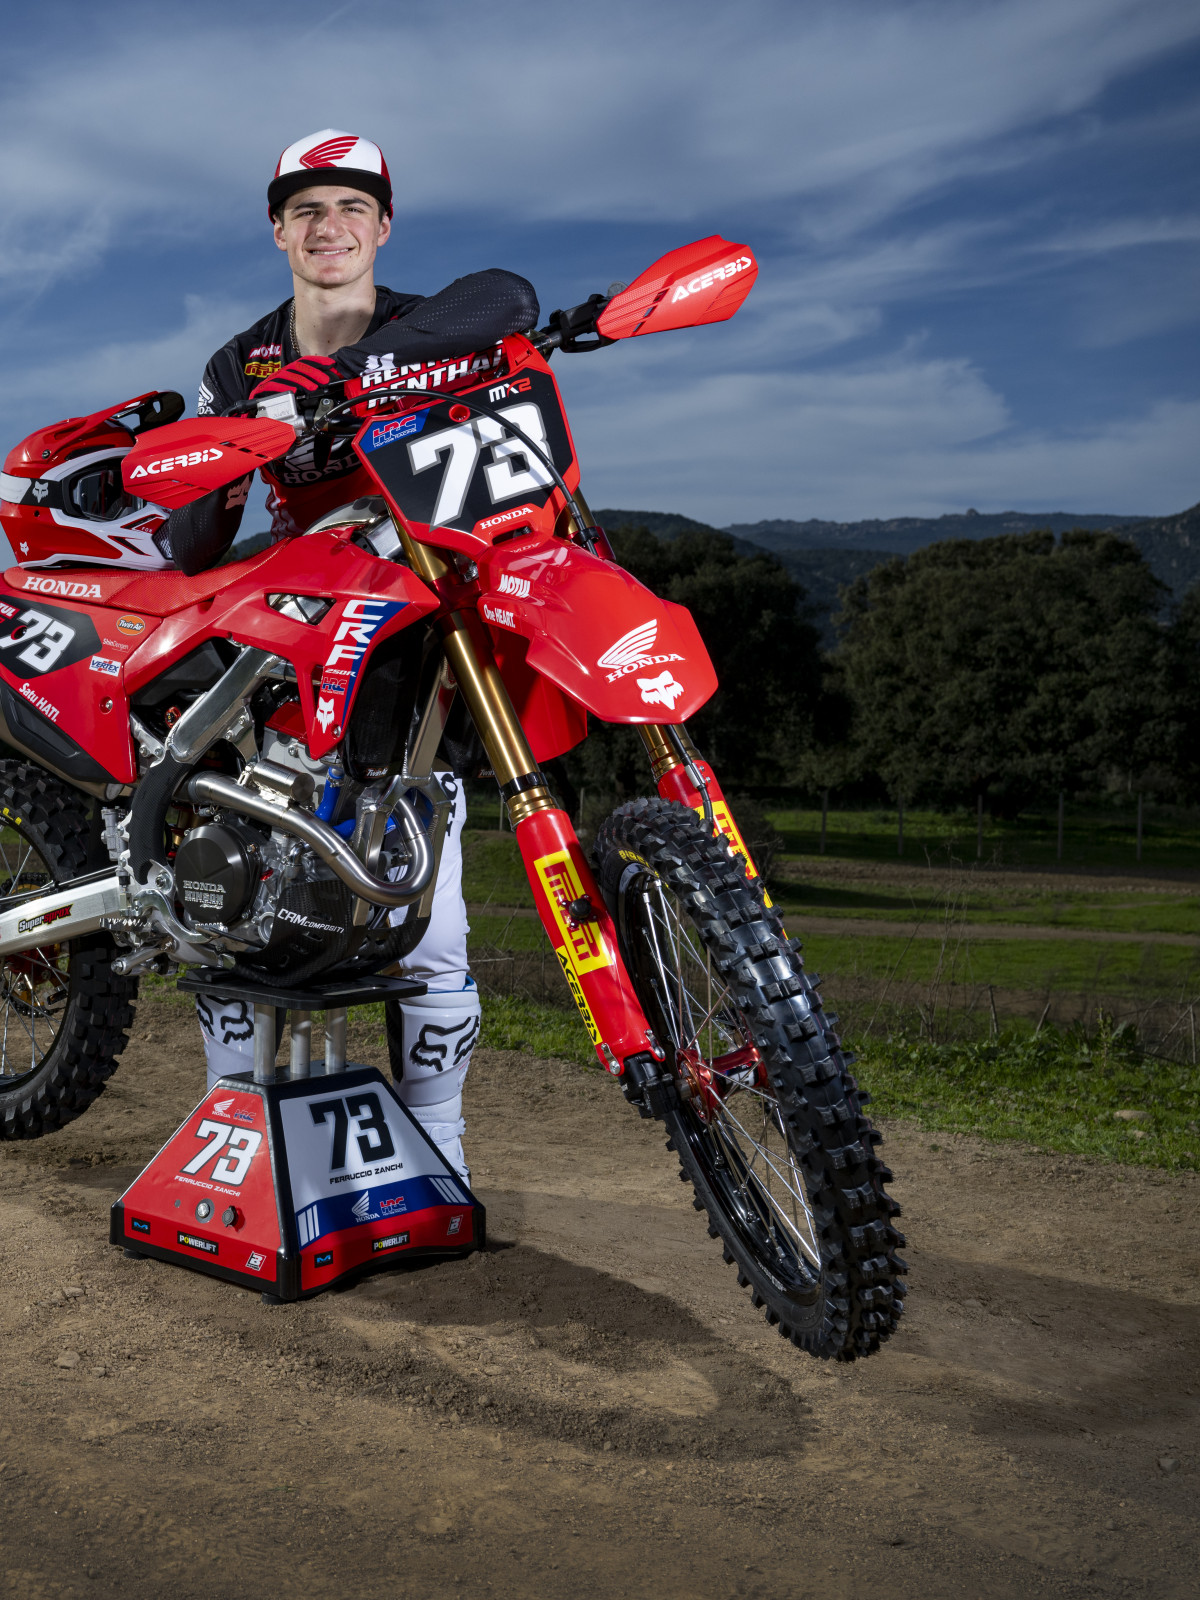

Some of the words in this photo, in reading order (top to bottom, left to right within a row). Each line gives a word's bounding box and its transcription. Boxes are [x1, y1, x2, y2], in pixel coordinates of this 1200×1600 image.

[249, 344, 281, 358] MOTUL
[488, 377, 532, 402] MX2
[407, 402, 556, 532] 73
[480, 507, 533, 530] HONDA
[22, 576, 102, 598] HONDA
[496, 573, 531, 598] MOTUL
[483, 604, 496, 621] One
[119, 619, 134, 629] Twin
[133, 622, 144, 631] Air
[325, 599, 388, 667] CRF
[91, 659, 120, 672] VERTEX
[605, 653, 686, 683] HONDA
[18, 682, 39, 703] Satu
[182, 879, 227, 894] HONDA
[18, 904, 73, 933] Supersprox
[211, 1110, 231, 1119] HONDA
[309, 1091, 396, 1172] 73
[181, 1118, 264, 1187] 73
[330, 1169, 373, 1185] FERRUCCIO
[374, 1162, 404, 1175] ZANCHI
[174, 1175, 214, 1190] FERRUCCIO
[213, 1185, 242, 1197] ZANCHI
[355, 1212, 381, 1223] HONDA
[180, 1234, 217, 1253] POWERLIFT
[373, 1234, 408, 1251] POWERLIFT
